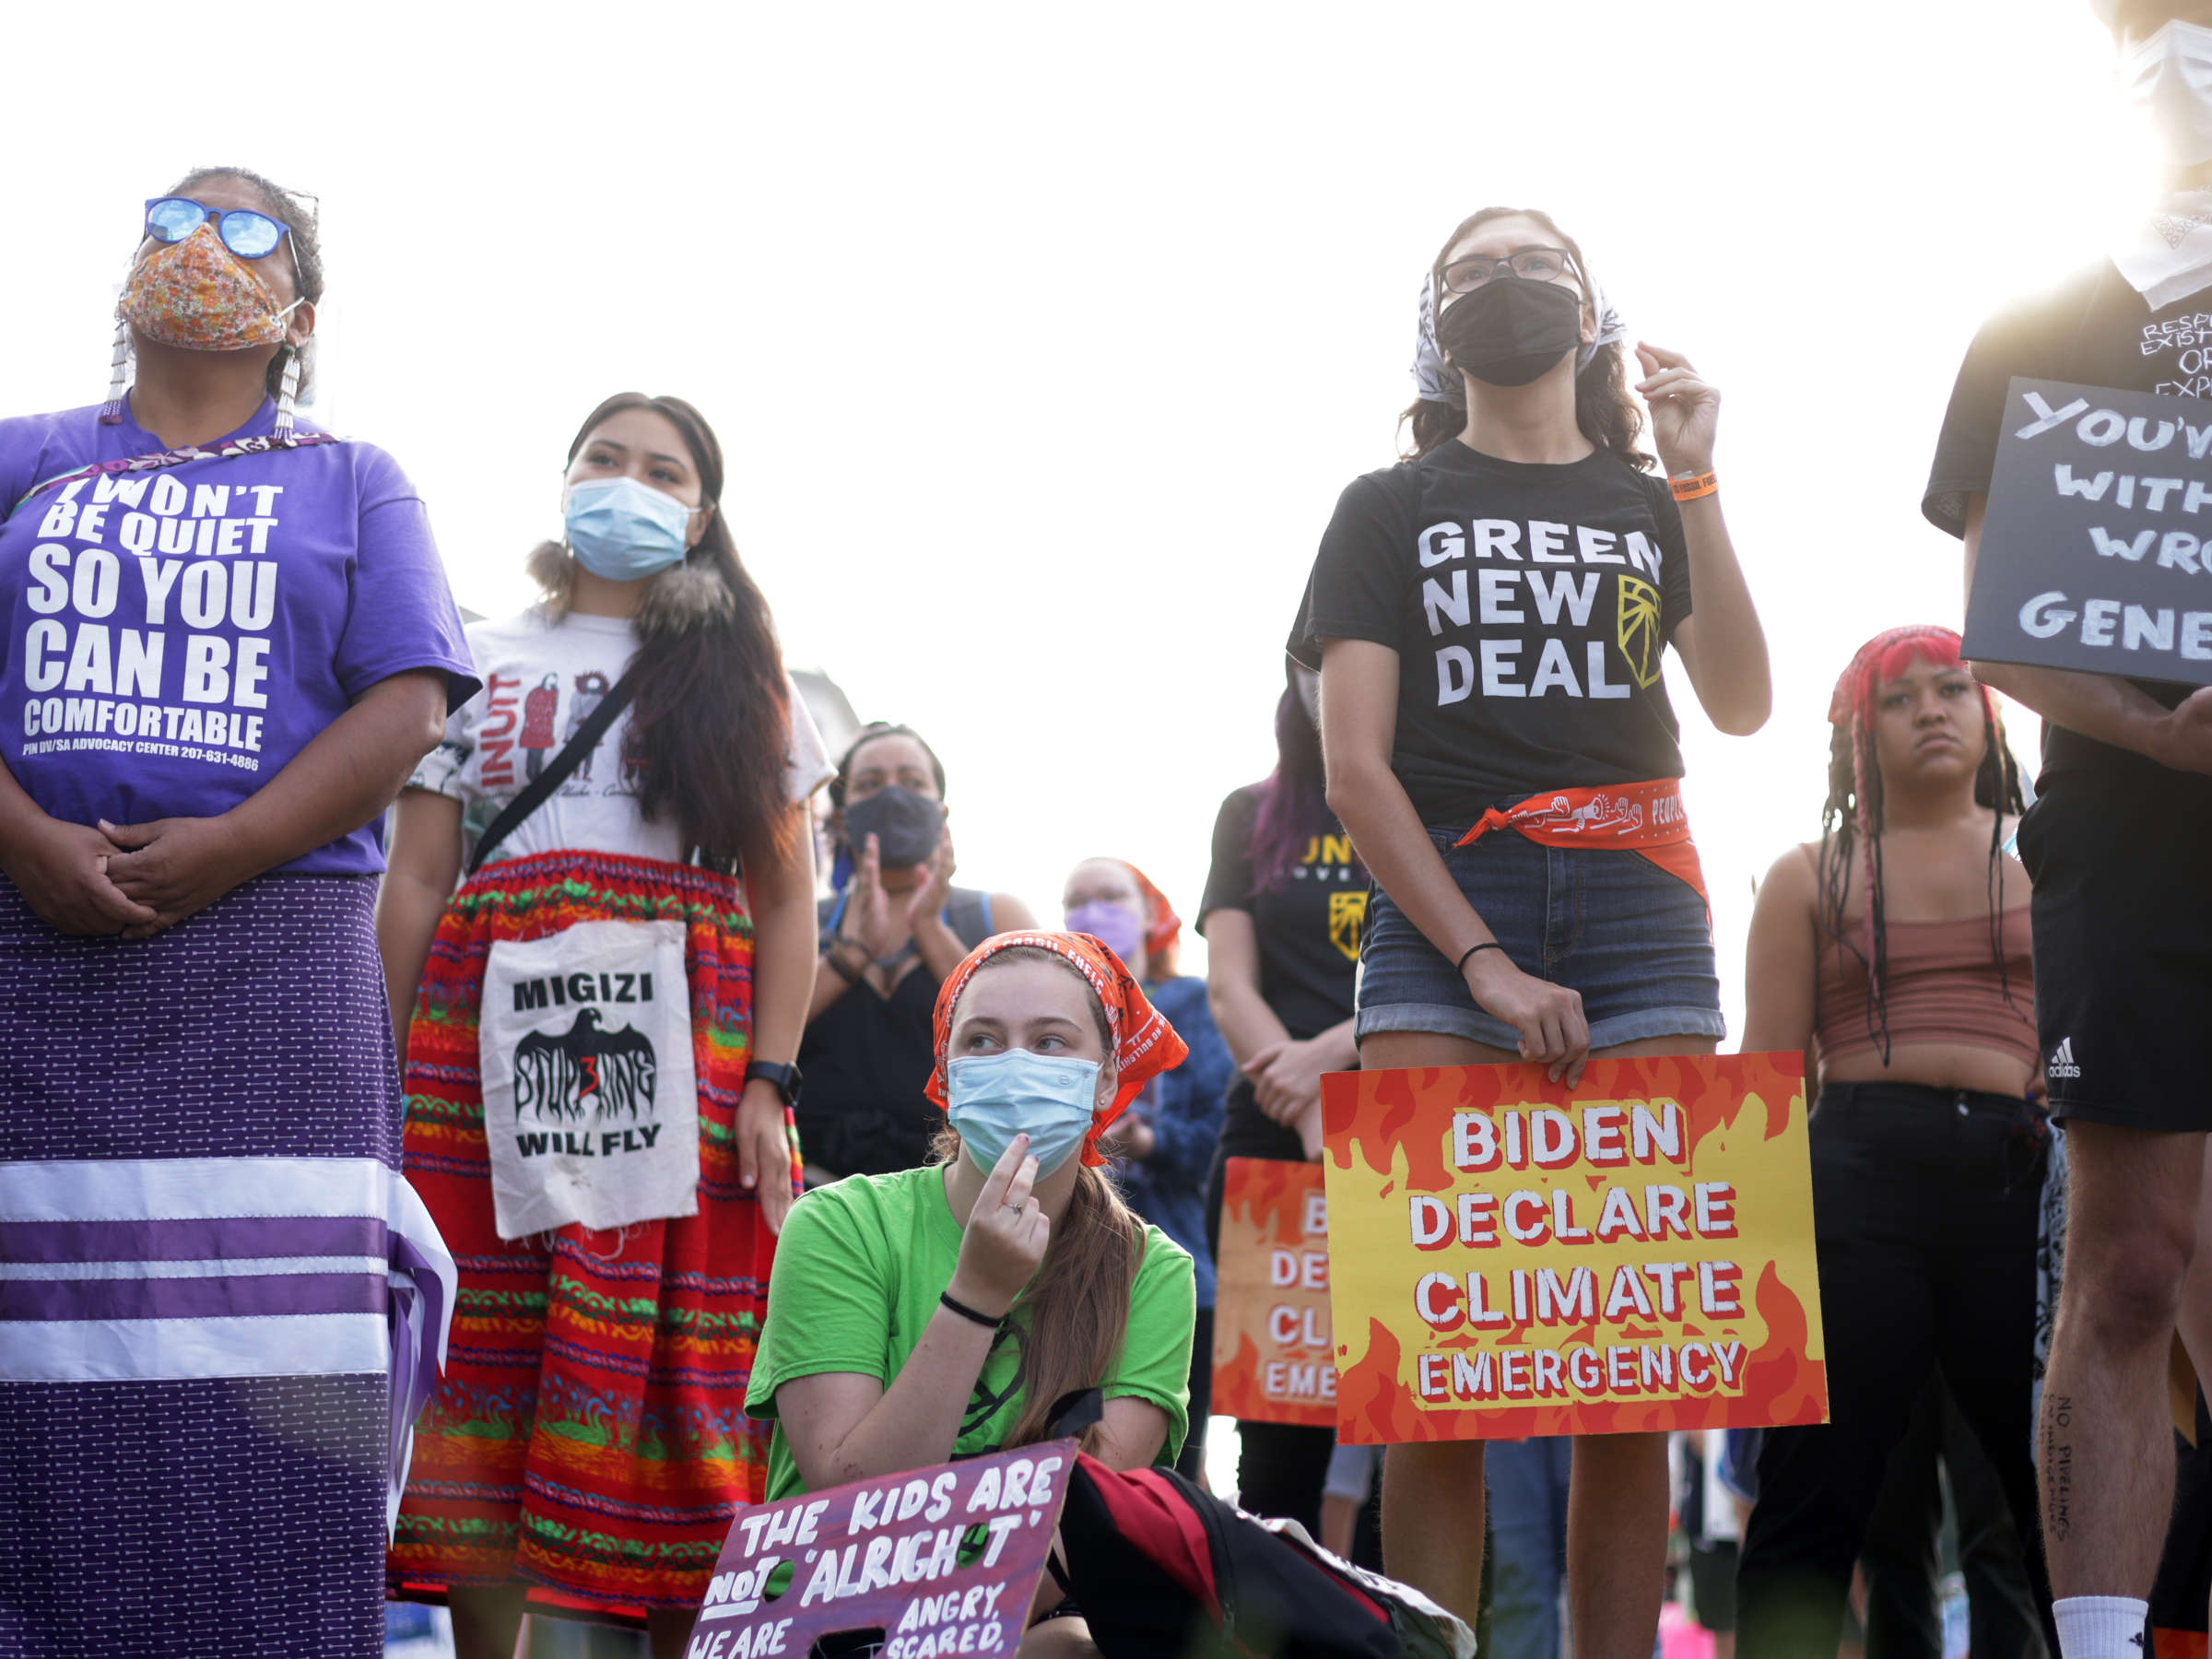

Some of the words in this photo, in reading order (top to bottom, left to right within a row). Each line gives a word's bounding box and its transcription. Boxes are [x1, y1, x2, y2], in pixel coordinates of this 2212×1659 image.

[2143, 312, 2212, 340] RESP
[2156, 376, 2212, 398] EXP
[2015, 391, 2212, 459] YOU'V
[92, 473, 283, 516] WON'T
[2054, 464, 2212, 513] WITH
[38, 500, 110, 543] BE
[120, 512, 278, 556] QUIET
[1418, 518, 1663, 585] GREEN
[28, 544, 120, 618] SO
[138, 557, 277, 630] YOU
[1422, 569, 1600, 636] NEW
[2019, 591, 2212, 661] GENE
[25, 619, 165, 698] CAN
[183, 635, 270, 709] BE
[1435, 638, 1630, 706] DEAL
[24, 698, 264, 752] COMFORTABLE
[480, 674, 521, 787] INUIT
[23, 743, 38, 756] PIN
[40, 738, 71, 753] DV/SA
[73, 738, 133, 752] ADVOCACY
[135, 743, 179, 757] CENTER
[181, 747, 259, 771] 207-631-4886
[513, 972, 653, 1012] MIGIZI
[2049, 1063, 2081, 1078] adidas
[516, 1131, 594, 1158] WILL
[602, 1123, 662, 1157] FLY
[1453, 1103, 1688, 1173] BIDEN
[1409, 1182, 1738, 1251] DECLARE
[1416, 1261, 1745, 1327] CLIMATE
[1418, 1341, 1747, 1402] EMERGENCY
[2056, 1396, 2072, 1428] NO
[740, 1500, 830, 1557] THE
[849, 1472, 957, 1535] KIDS
[967, 1456, 1062, 1512] ARE
[2058, 1445, 2072, 1542] PIPELINES
[704, 1556, 780, 1606] NOT
[898, 1582, 1006, 1634] ANGRY,
[688, 1630, 732, 1659] WE
[728, 1618, 794, 1659] ARE
[887, 1621, 1005, 1659] SCARED,
